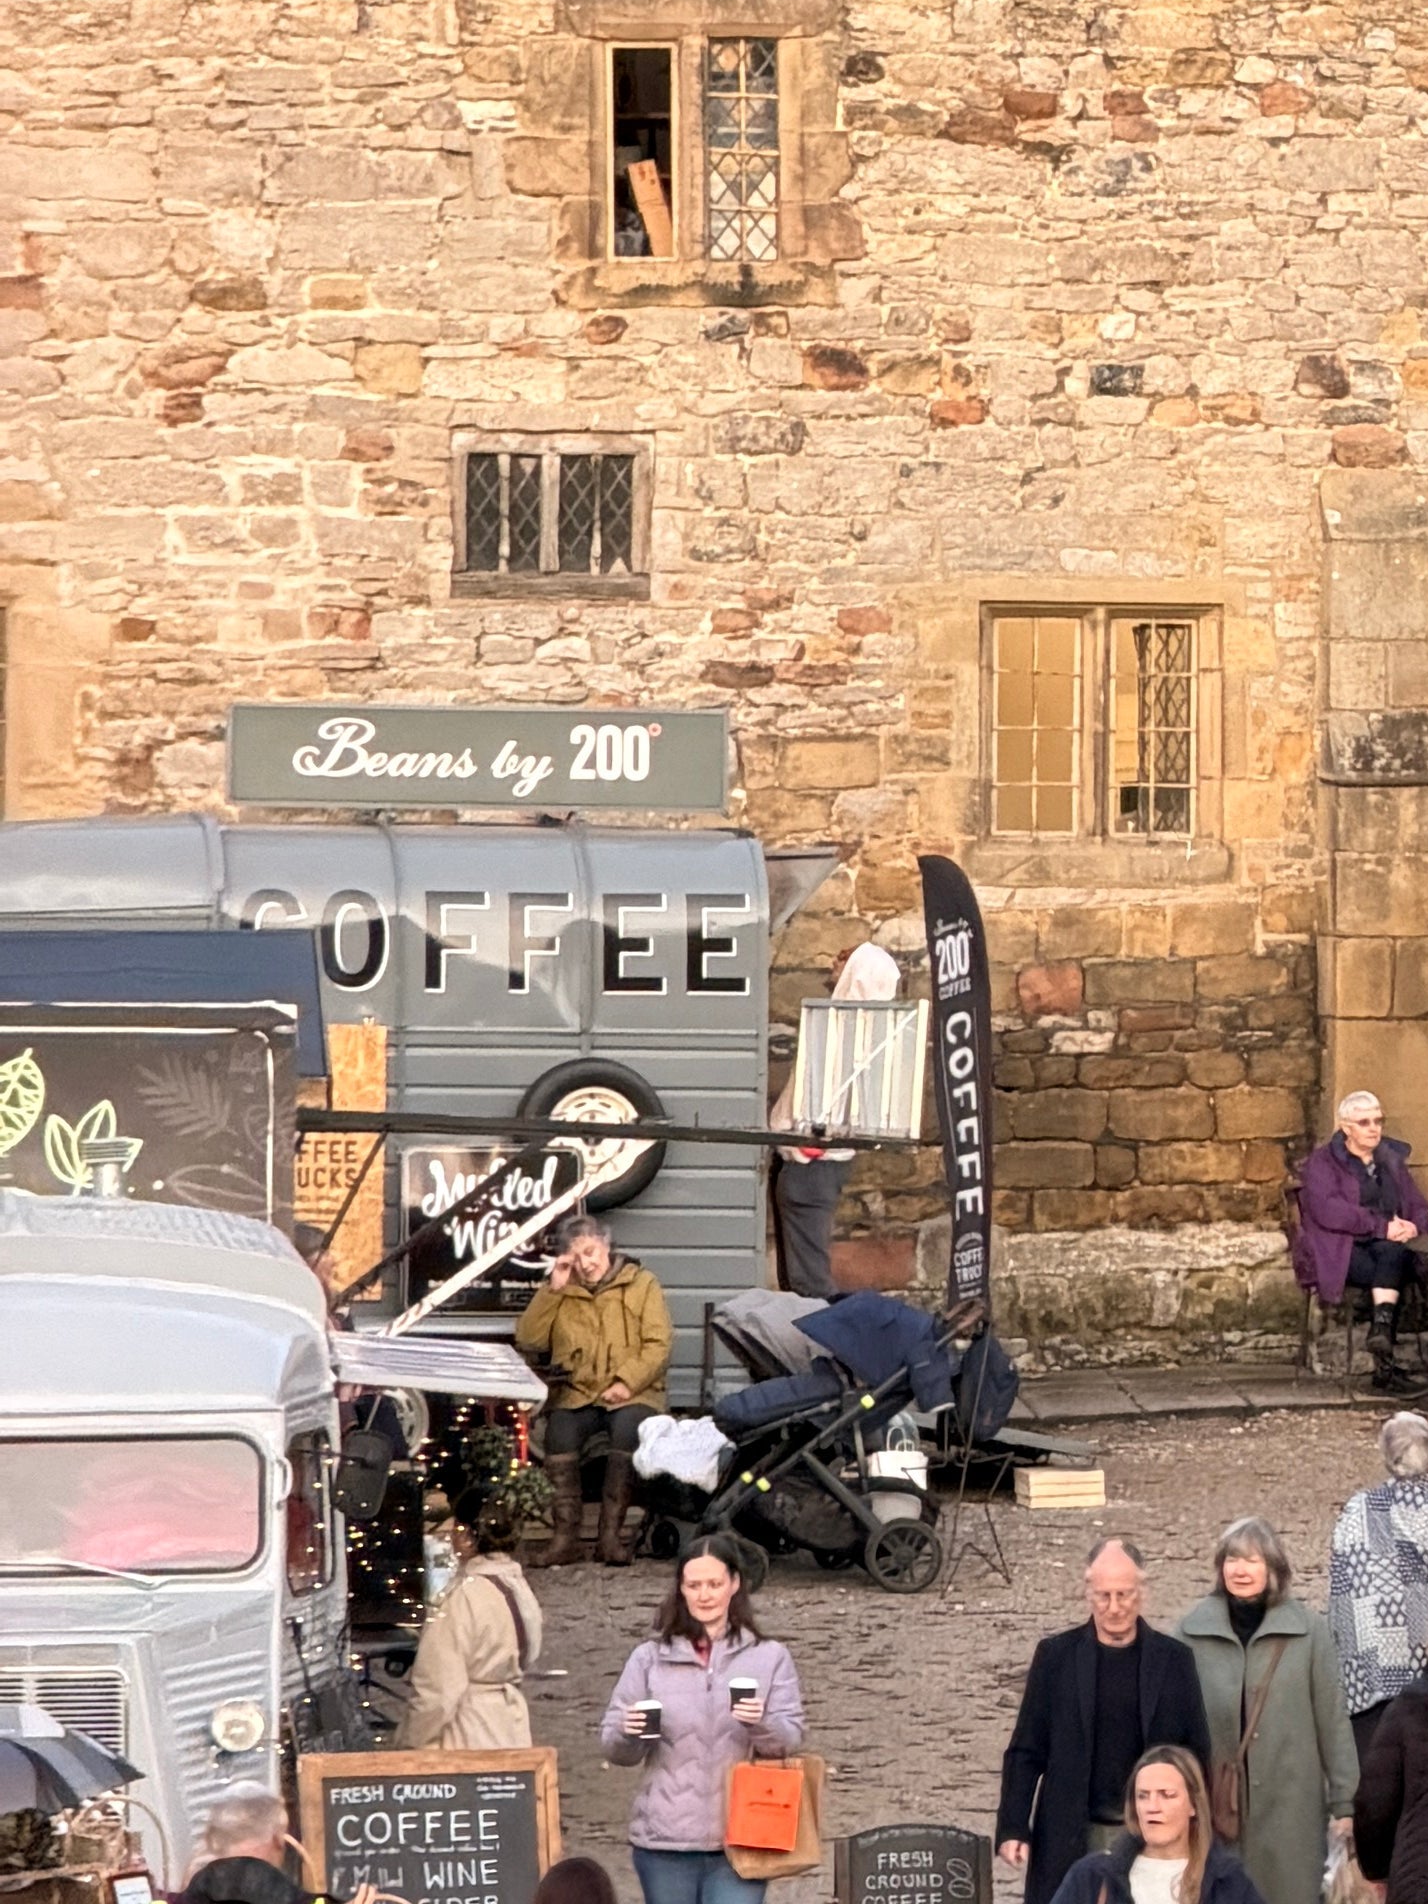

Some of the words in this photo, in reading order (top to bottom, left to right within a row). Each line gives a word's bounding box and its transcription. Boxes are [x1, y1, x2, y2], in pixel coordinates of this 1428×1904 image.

[292, 717, 477, 778] Beans
[491, 740, 554, 797] by
[946, 1011, 984, 1221] COFFEE
[297, 1140, 358, 1163] FFEE
[297, 1167, 358, 1188] UCKS
[330, 1785, 384, 1805] FRESH
[392, 1784, 457, 1804] GROUND
[337, 1809, 499, 1847] COFFEE
[877, 1851, 934, 1871] FRESH
[423, 1858, 499, 1890] WINE
[865, 1874, 944, 1890] GROUND
